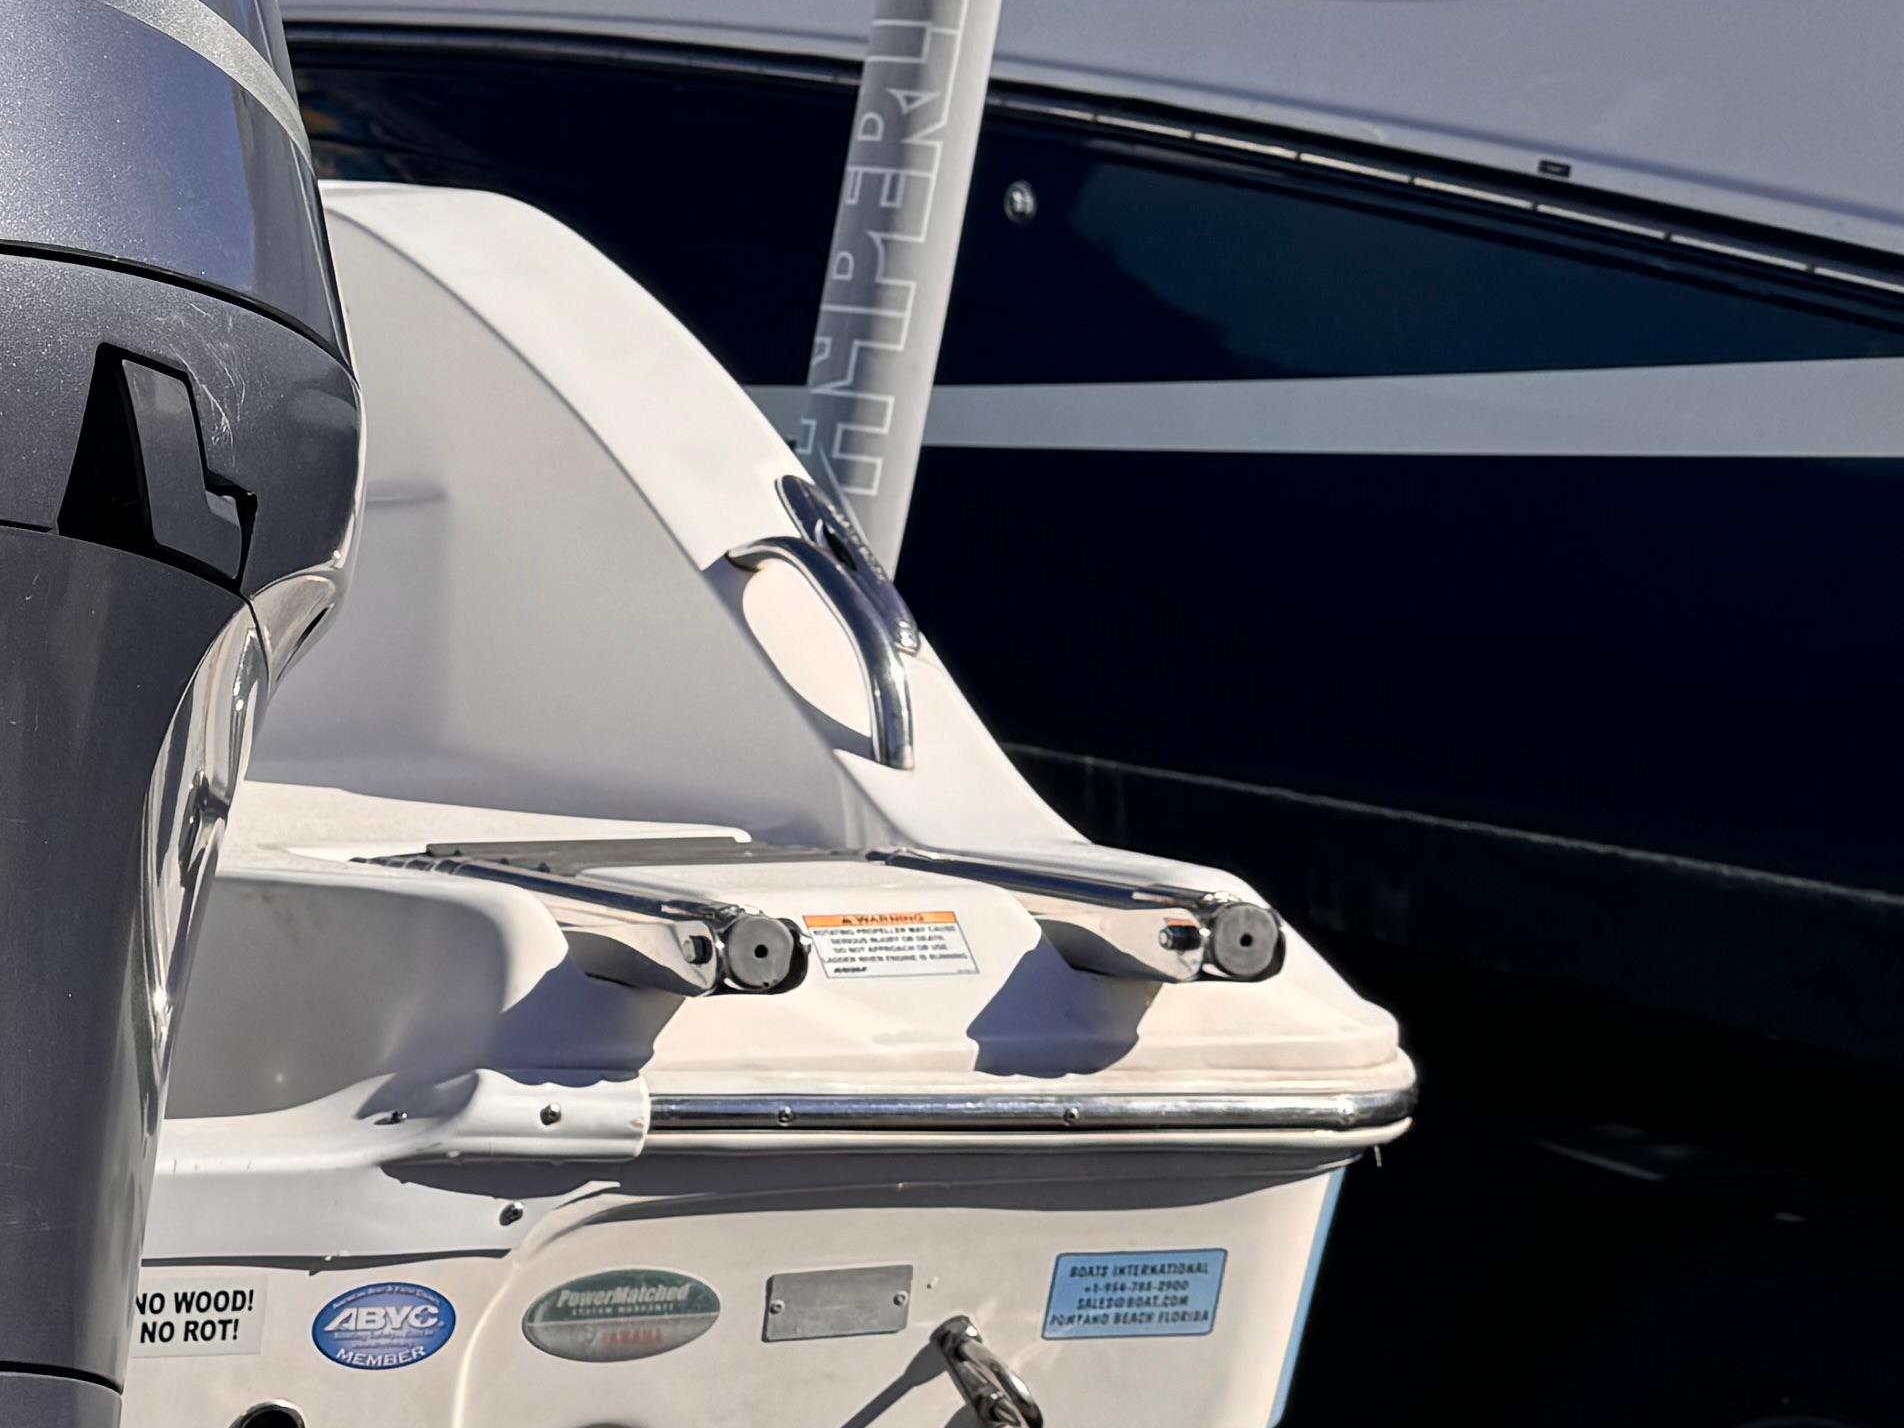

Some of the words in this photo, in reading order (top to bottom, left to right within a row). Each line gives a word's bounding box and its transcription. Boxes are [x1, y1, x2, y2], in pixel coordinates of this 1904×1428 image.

[1069, 1265, 1109, 1278] BOATS
[1112, 1262, 1210, 1277] INTERNATIONAL
[136, 1292, 165, 1315] NO
[174, 1289, 254, 1314] WOOD!
[556, 1282, 693, 1308] PowerMatched
[1076, 1295, 1189, 1311] SALES@BOAT.COM
[323, 1304, 440, 1331] ABYC
[140, 1321, 175, 1344] NO
[183, 1318, 240, 1342] ROT!
[336, 1346, 427, 1367] MEMBER
